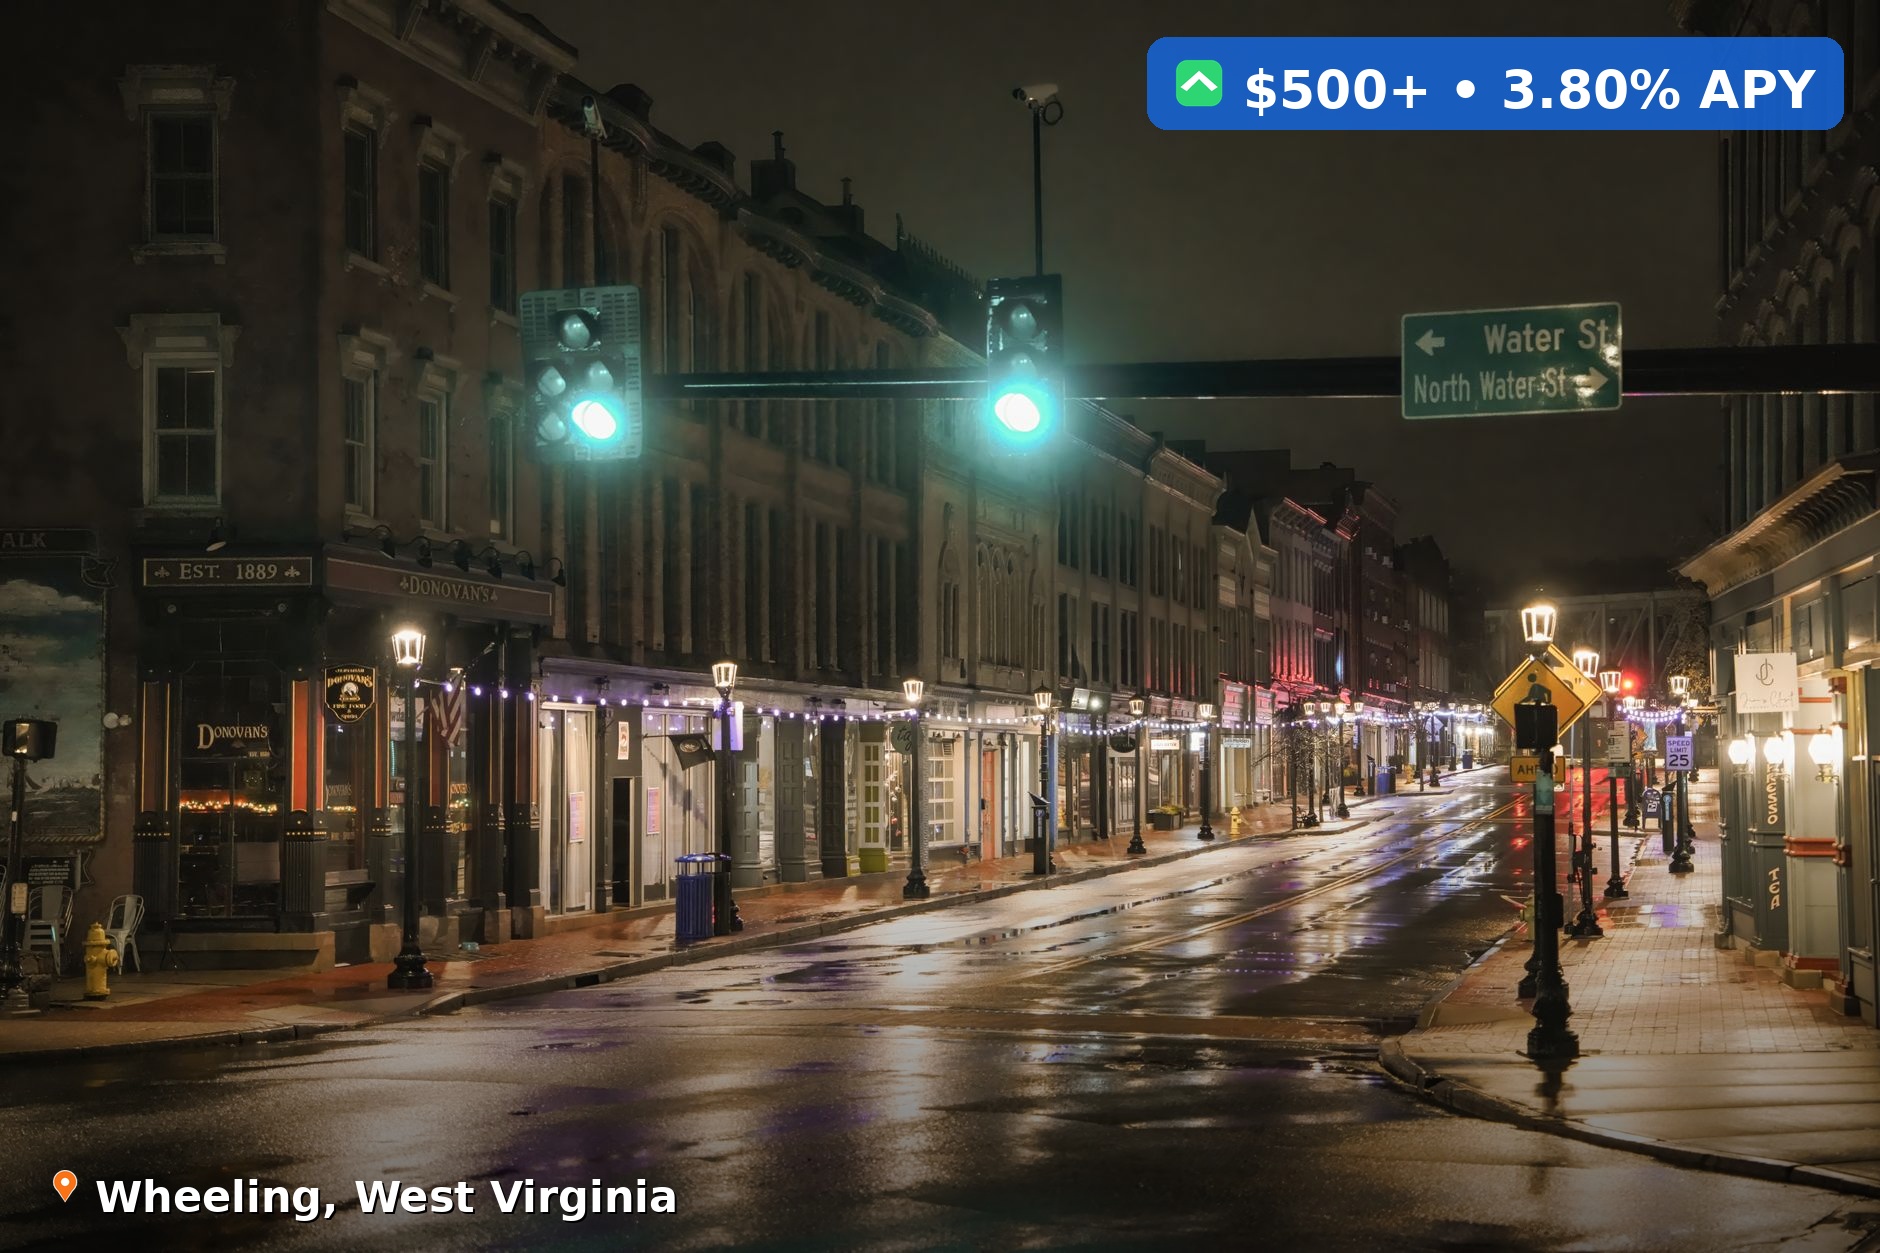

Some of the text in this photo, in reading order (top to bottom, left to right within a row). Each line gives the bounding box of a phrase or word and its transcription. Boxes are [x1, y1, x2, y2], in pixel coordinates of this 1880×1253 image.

[1484, 319, 1609, 355] Water St
[1414, 367, 1567, 404] North Water St
[179, 563, 278, 580] EST. 1889
[408, 575, 490, 602] DONOVAN'S
[197, 723, 268, 750] DONOVAN'S
[1668, 754, 1690, 767] 25
[1768, 867, 1780, 911] TEA
